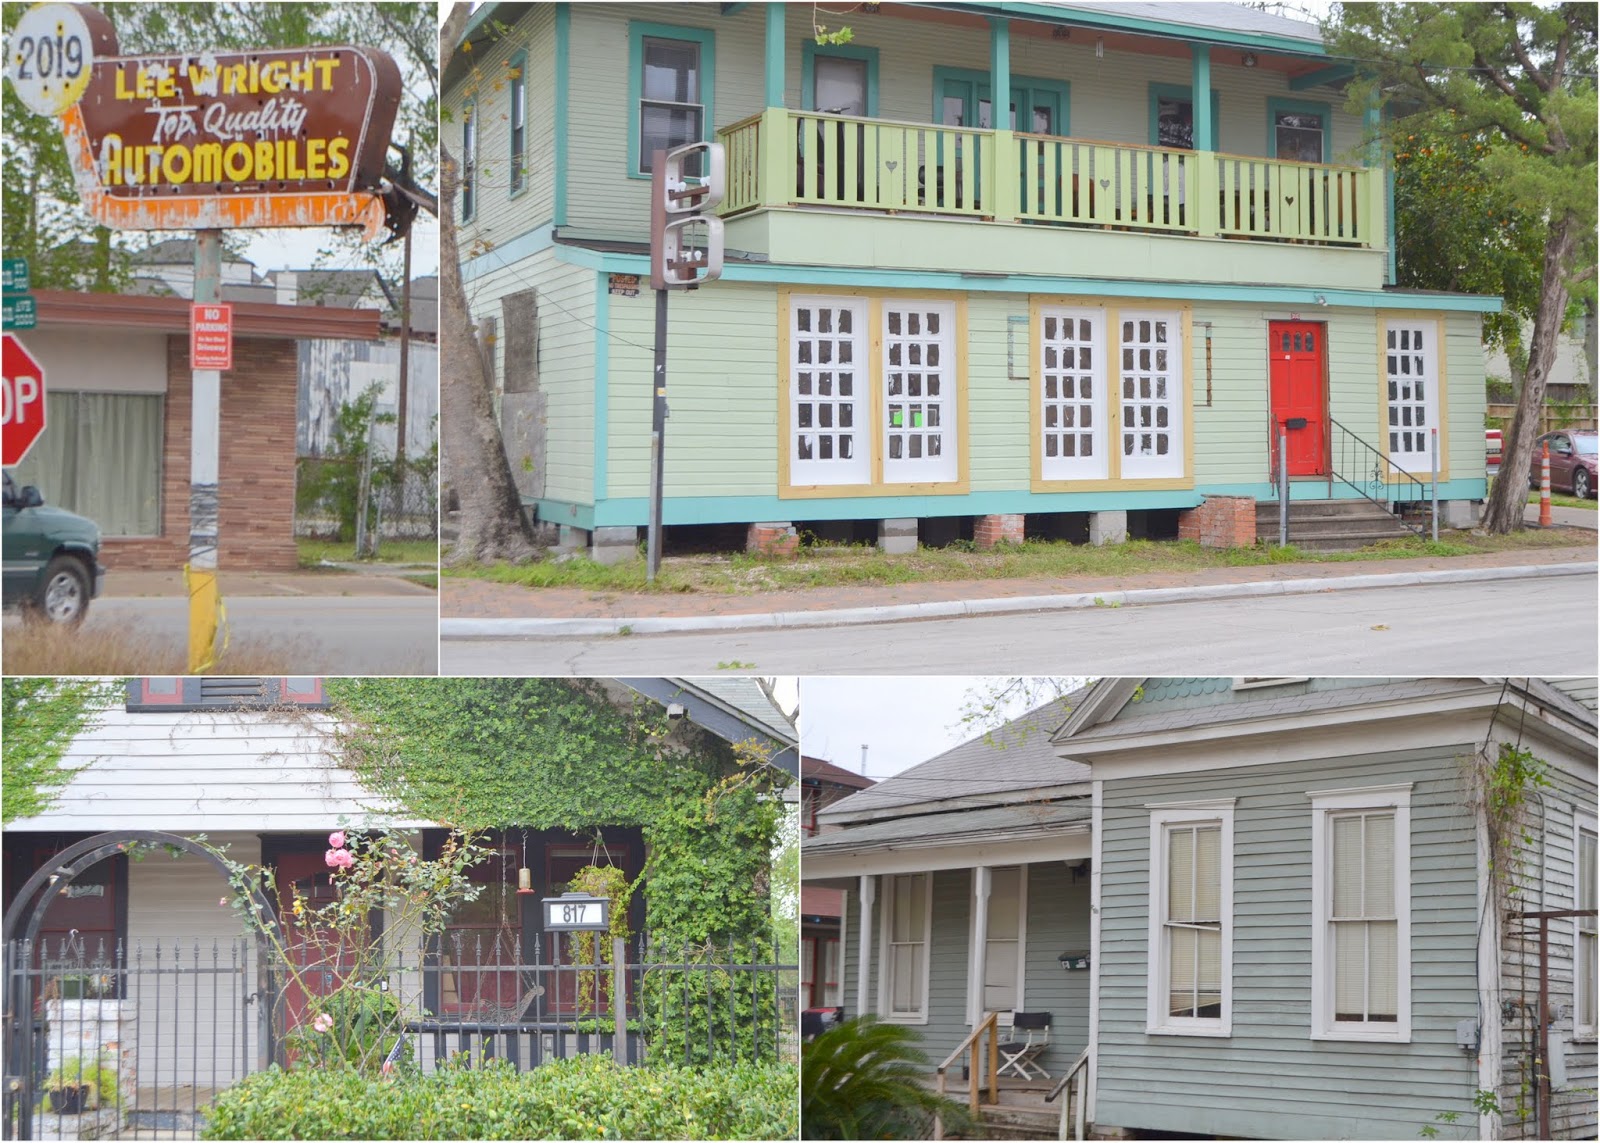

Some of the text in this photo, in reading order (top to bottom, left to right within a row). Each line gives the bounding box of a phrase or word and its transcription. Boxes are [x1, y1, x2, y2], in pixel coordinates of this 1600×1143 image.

[18, 35, 83, 80] 2019
[115, 59, 341, 100] LEE WRIGHT
[203, 98, 308, 140] Quality
[102, 133, 350, 186] AUTOMOBILES
[195, 322, 228, 333] PARKING
[204, 308, 220, 321] NO
[197, 343, 227, 353] Driveway
[563, 903, 586, 924] 817
